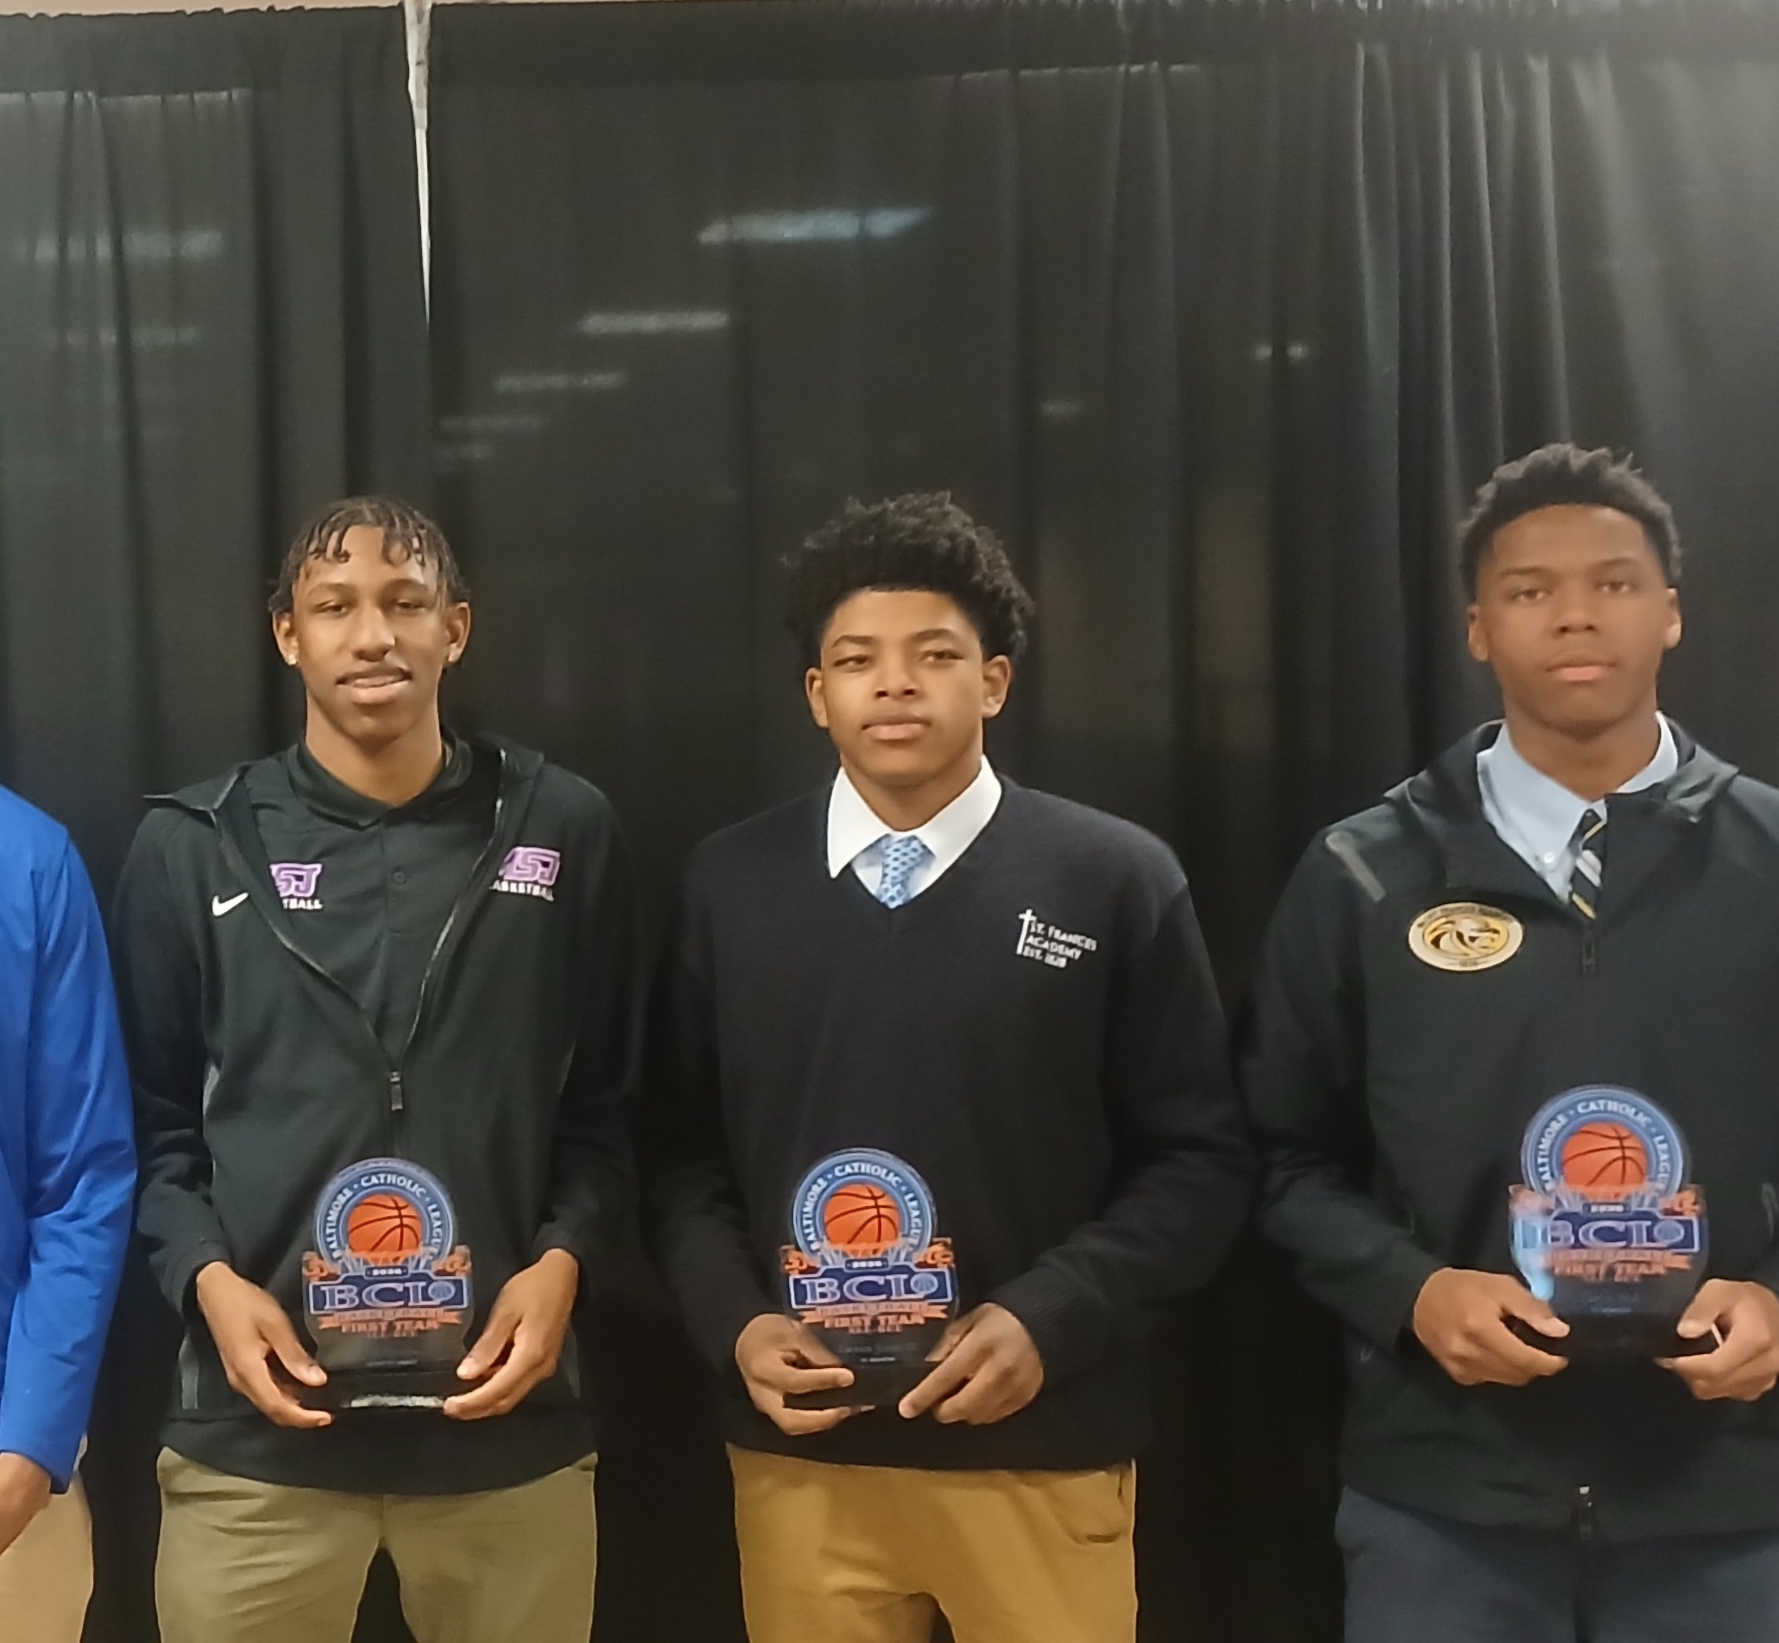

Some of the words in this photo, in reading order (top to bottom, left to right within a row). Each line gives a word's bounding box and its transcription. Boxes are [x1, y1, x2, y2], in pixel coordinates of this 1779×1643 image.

[1026, 935, 1082, 960] ACADEMY
[1577, 1099, 1652, 1128] CATHOLIC
[360, 1173, 427, 1198] CATHOLIC
[834, 1161, 903, 1187] CATHOLIC
[321, 1282, 442, 1310] BCL
[801, 1274, 925, 1304] BCL
